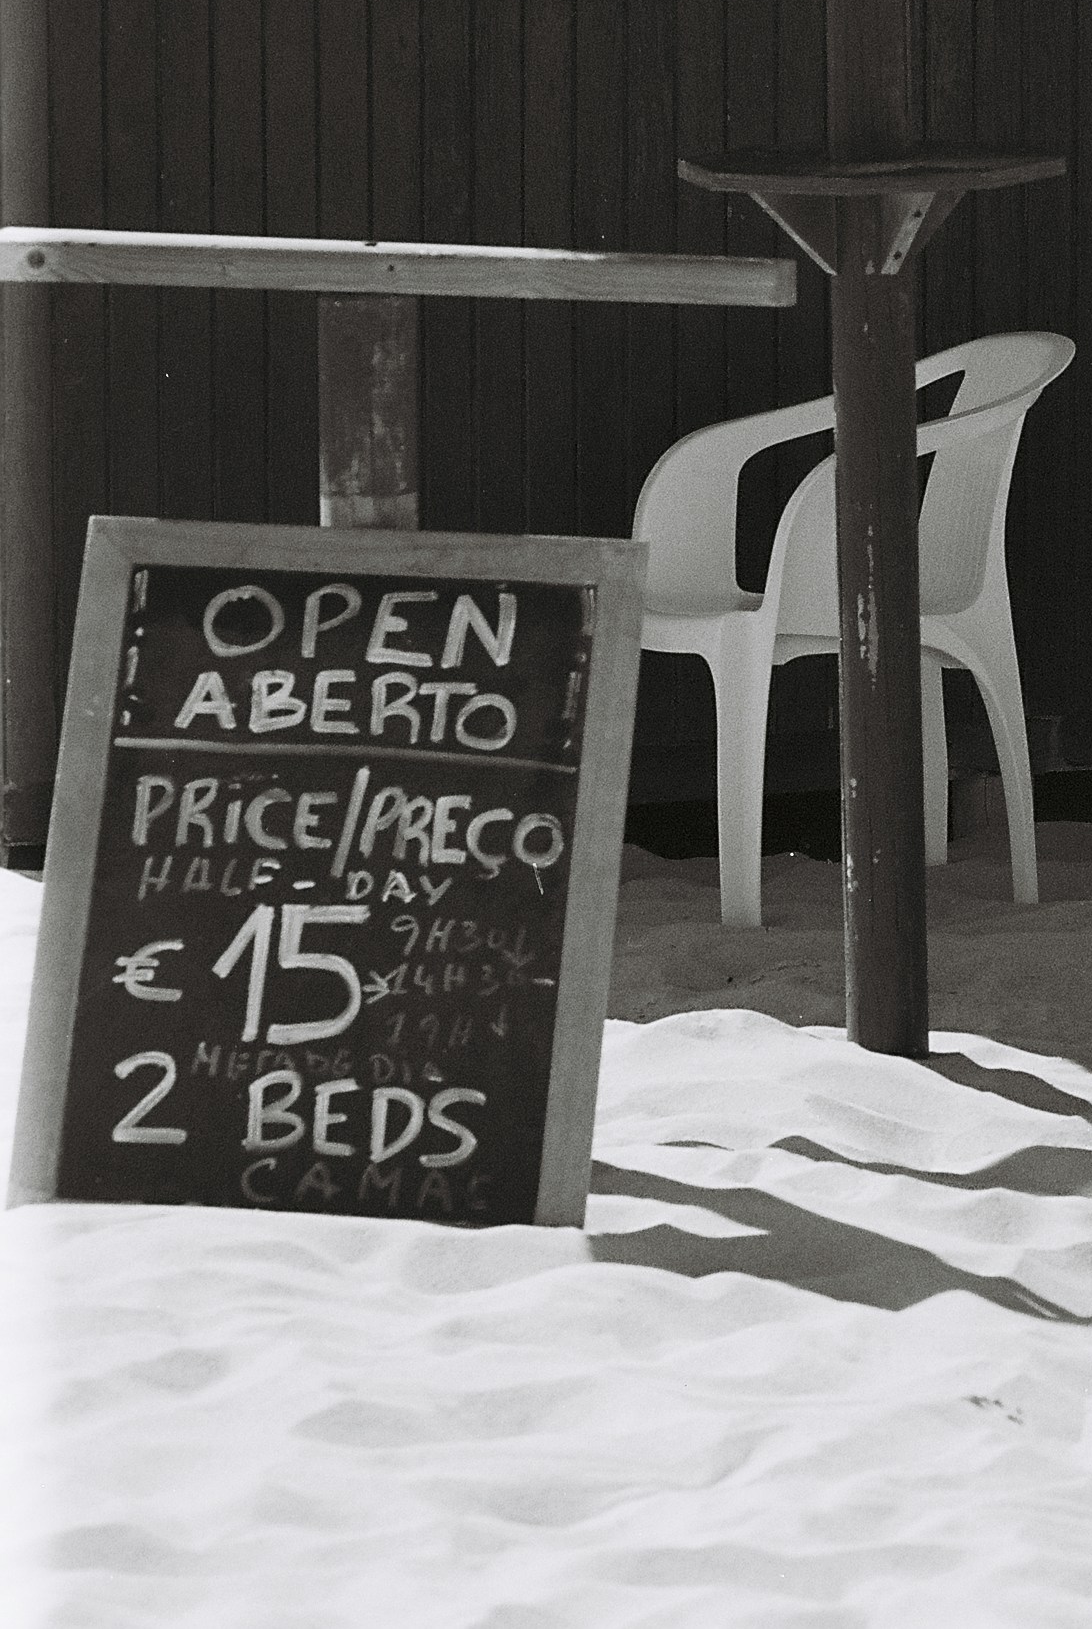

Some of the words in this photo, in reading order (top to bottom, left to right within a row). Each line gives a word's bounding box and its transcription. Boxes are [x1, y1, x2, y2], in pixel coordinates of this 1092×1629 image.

[203, 583, 517, 669] OPEN
[174, 669, 517, 751] ABERTO
[112, 939, 185, 1002] €
[211, 903, 371, 1045] 15
[111, 1050, 188, 1145] 2
[241, 1069, 487, 1169] BEDS
